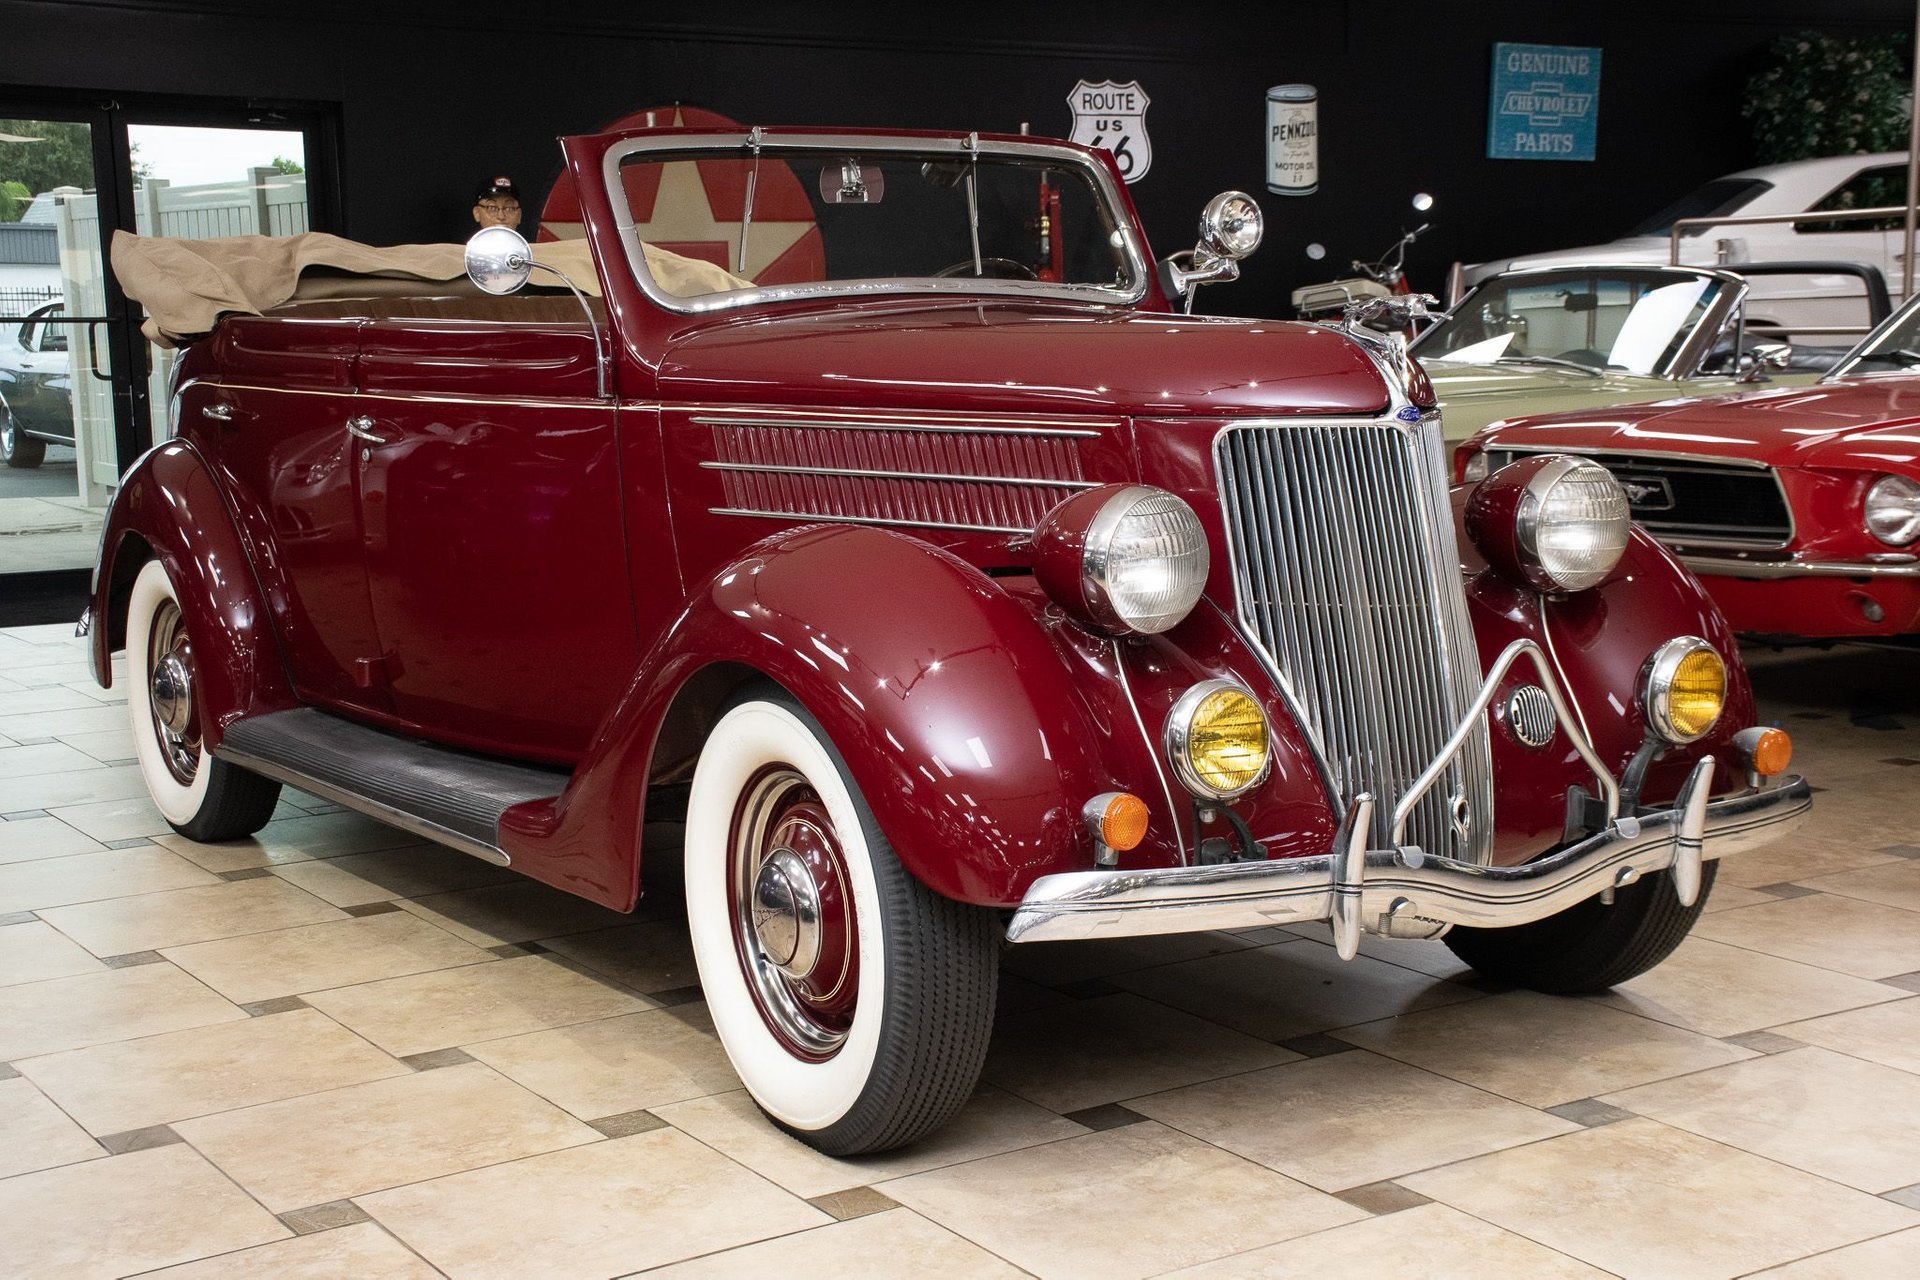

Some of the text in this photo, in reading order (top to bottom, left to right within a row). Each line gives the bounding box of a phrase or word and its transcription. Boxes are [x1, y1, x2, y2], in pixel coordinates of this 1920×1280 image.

[1508, 53, 1589, 74] GENUINE
[1083, 93, 1135, 110] ROUTE
[1508, 95, 1585, 113] CHEVROLET
[1096, 120, 1123, 131] US
[1272, 120, 1316, 142] PENNZOIL
[1514, 132, 1574, 153] PARTS
[1090, 135, 1134, 175] 6
[1275, 161, 1315, 171] MOTOR OIL
